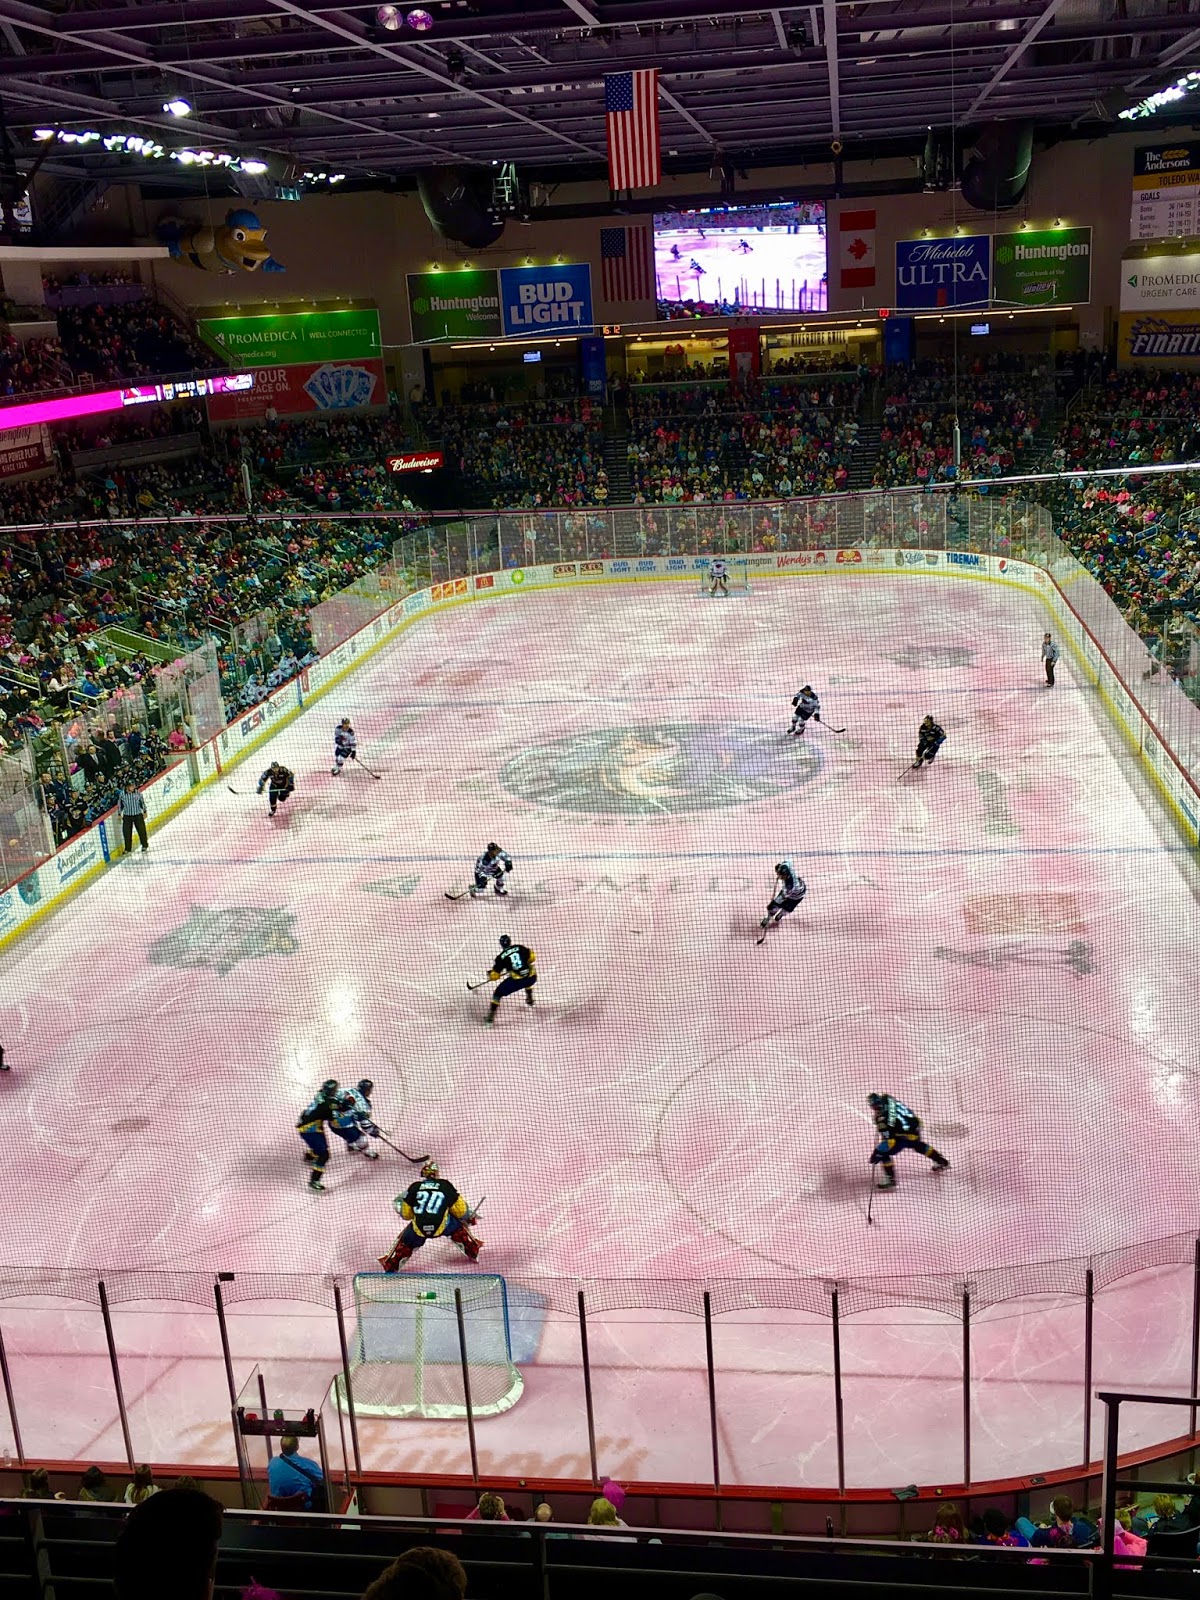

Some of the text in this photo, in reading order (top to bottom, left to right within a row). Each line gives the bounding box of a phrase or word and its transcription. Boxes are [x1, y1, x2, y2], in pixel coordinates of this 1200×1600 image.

[1145, 152, 1161, 162] The
[1144, 159, 1191, 171] Andersons
[1159, 175, 1186, 186] TOLEDO
[1140, 192, 1160, 201] GOALS
[908, 243, 975, 263] Michelob
[1015, 243, 1089, 260] Huntington
[898, 261, 988, 286] ULTRA
[519, 282, 573, 304] BUD
[1140, 287, 1197, 298] URGENT CARE
[430, 296, 499, 311] Huntington
[510, 301, 584, 325] LIGHT
[328, 328, 368, 337] CONNECTED
[8, 449, 25, 462] POWER
[2, 463, 15, 472] SINCE
[390, 457, 439, 471] Budweiser
[777, 553, 812, 568] Wendy's
[946, 552, 979, 565] TIREMAN
[241, 708, 265, 737] BCSN
[413, 1190, 445, 1214] 30
